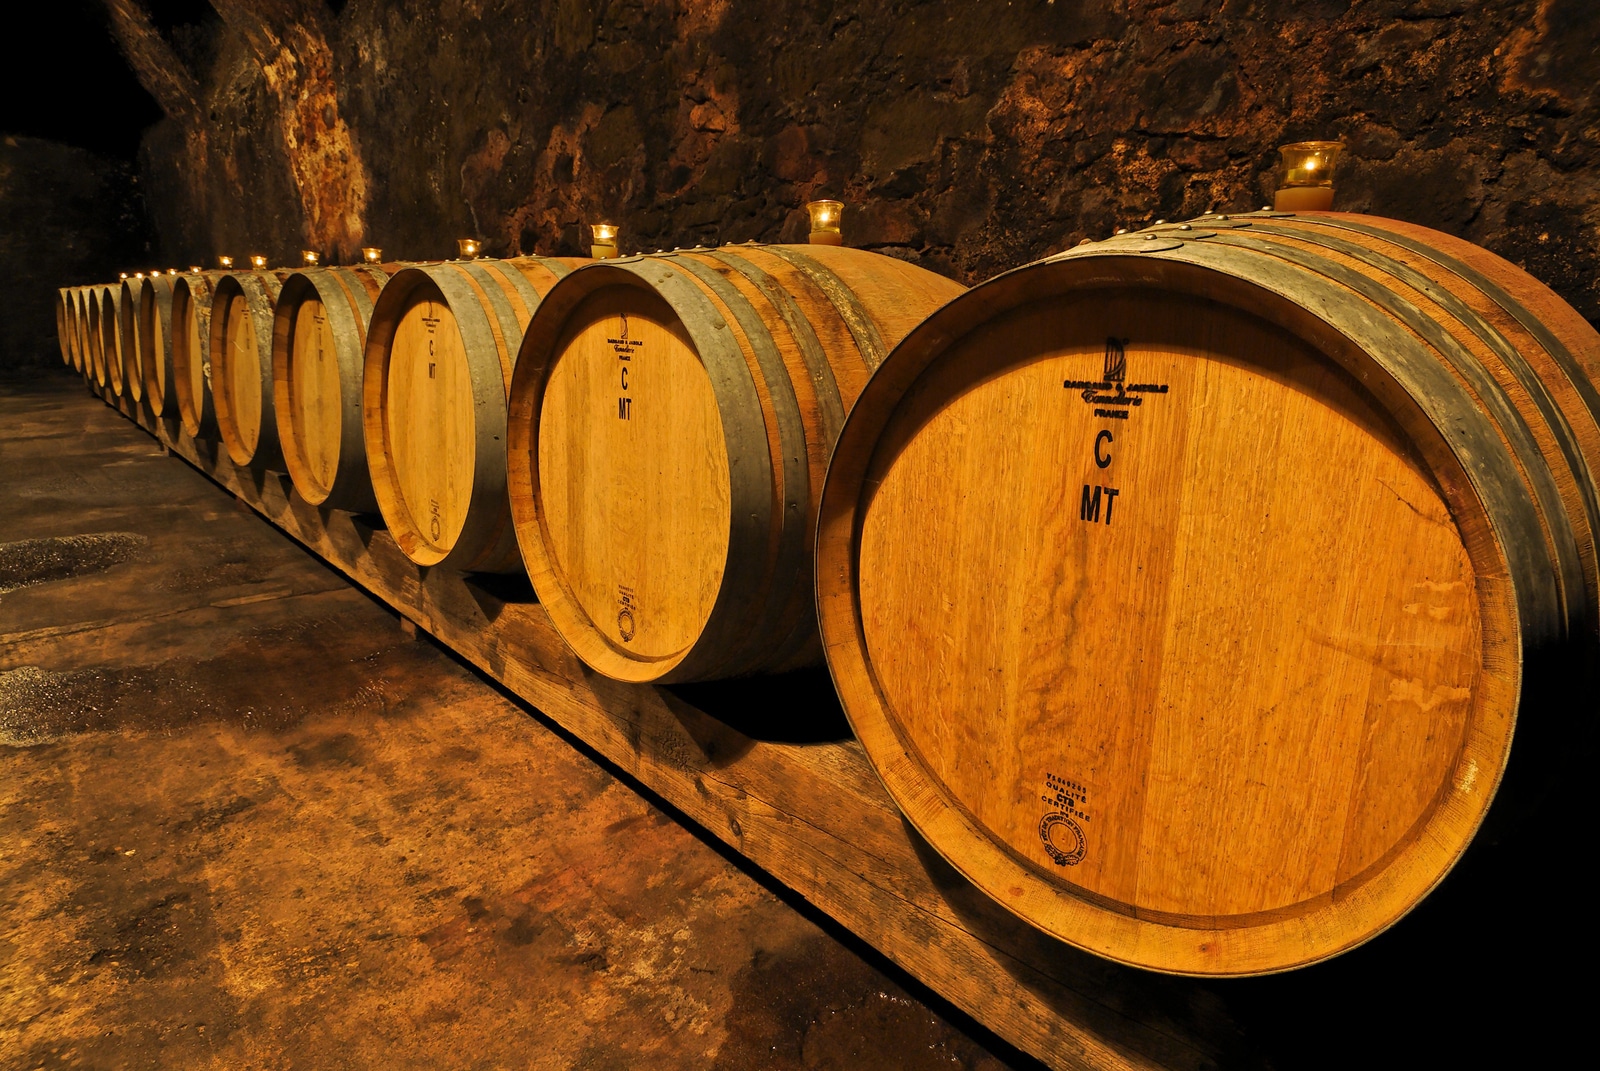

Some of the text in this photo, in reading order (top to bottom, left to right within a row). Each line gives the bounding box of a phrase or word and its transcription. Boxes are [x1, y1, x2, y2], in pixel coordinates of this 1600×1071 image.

[621, 366, 628, 391] C
[618, 397, 632, 421] MT
[1094, 408, 1129, 420] FRANCE
[1094, 429, 1113, 469] C
[1080, 484, 1119, 525] MT
